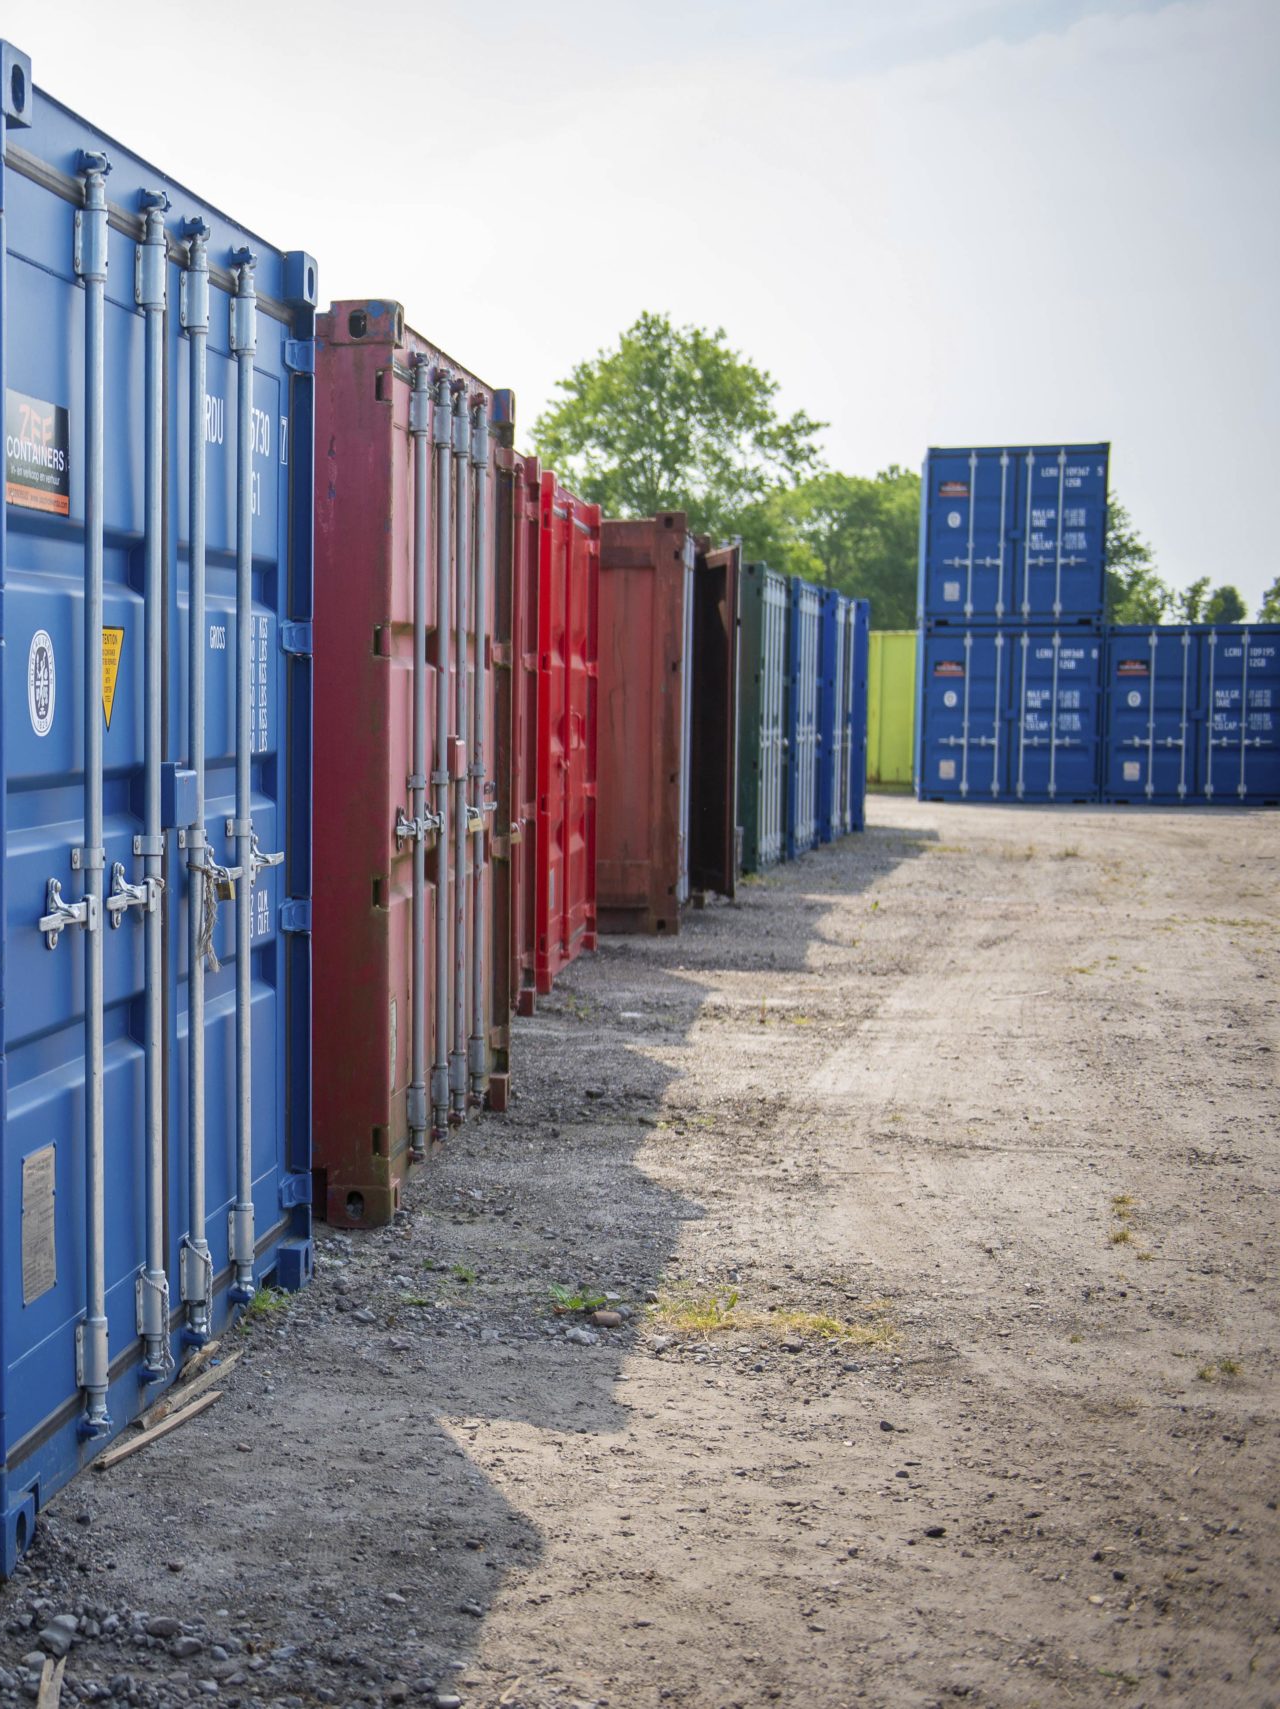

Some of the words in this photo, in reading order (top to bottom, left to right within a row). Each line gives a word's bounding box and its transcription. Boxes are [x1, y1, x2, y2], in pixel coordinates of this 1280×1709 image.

[6, 435, 65, 472] CONTAINERS
[209, 625, 226, 649] GROSS
[259, 616, 267, 639] KGS
[259, 639, 267, 662] LBS
[259, 662, 267, 684] KGS
[258, 685, 267, 707] LBS
[259, 708, 268, 730] KGS
[258, 730, 268, 753] LBS
